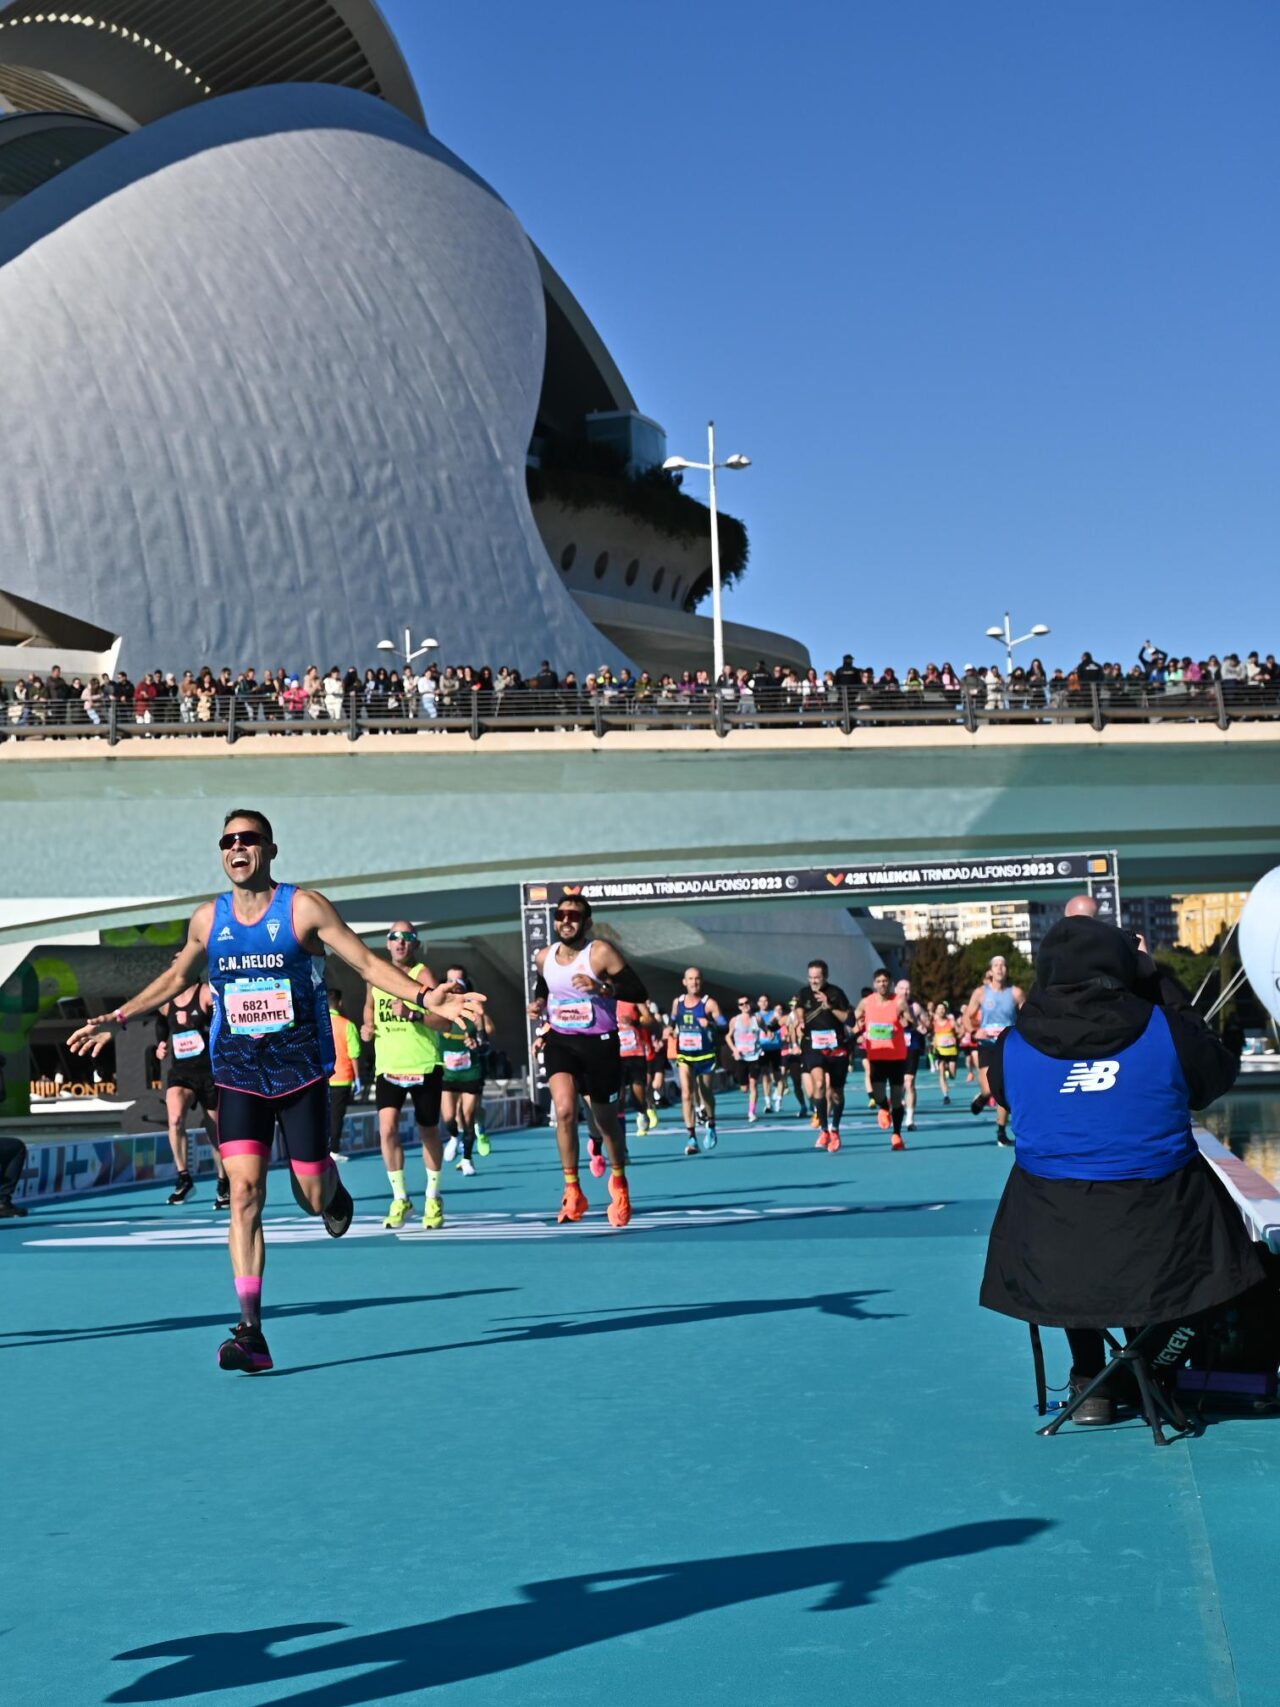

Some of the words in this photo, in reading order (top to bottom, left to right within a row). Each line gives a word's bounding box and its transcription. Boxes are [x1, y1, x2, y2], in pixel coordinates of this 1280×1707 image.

[844, 872, 868, 885] 42K
[868, 869, 921, 884] VALENCIA
[921, 867, 969, 881] TRINIDAD
[970, 864, 1021, 879] ALFONSO
[1022, 862, 1054, 876] 2023
[580, 885, 604, 897] 42K
[603, 882, 654, 896] VALENCIA
[654, 880, 701, 894] TRINIDAD
[701, 878, 751, 892] ALFONSO
[751, 876, 782, 890] 2023
[241, 953, 284, 969] HELIOS
[242, 1000, 269, 1011] 6821
[230, 1012, 236, 1023] C
[238, 1009, 290, 1023] MORATIEL
[1060, 1060, 1120, 1093] NB
